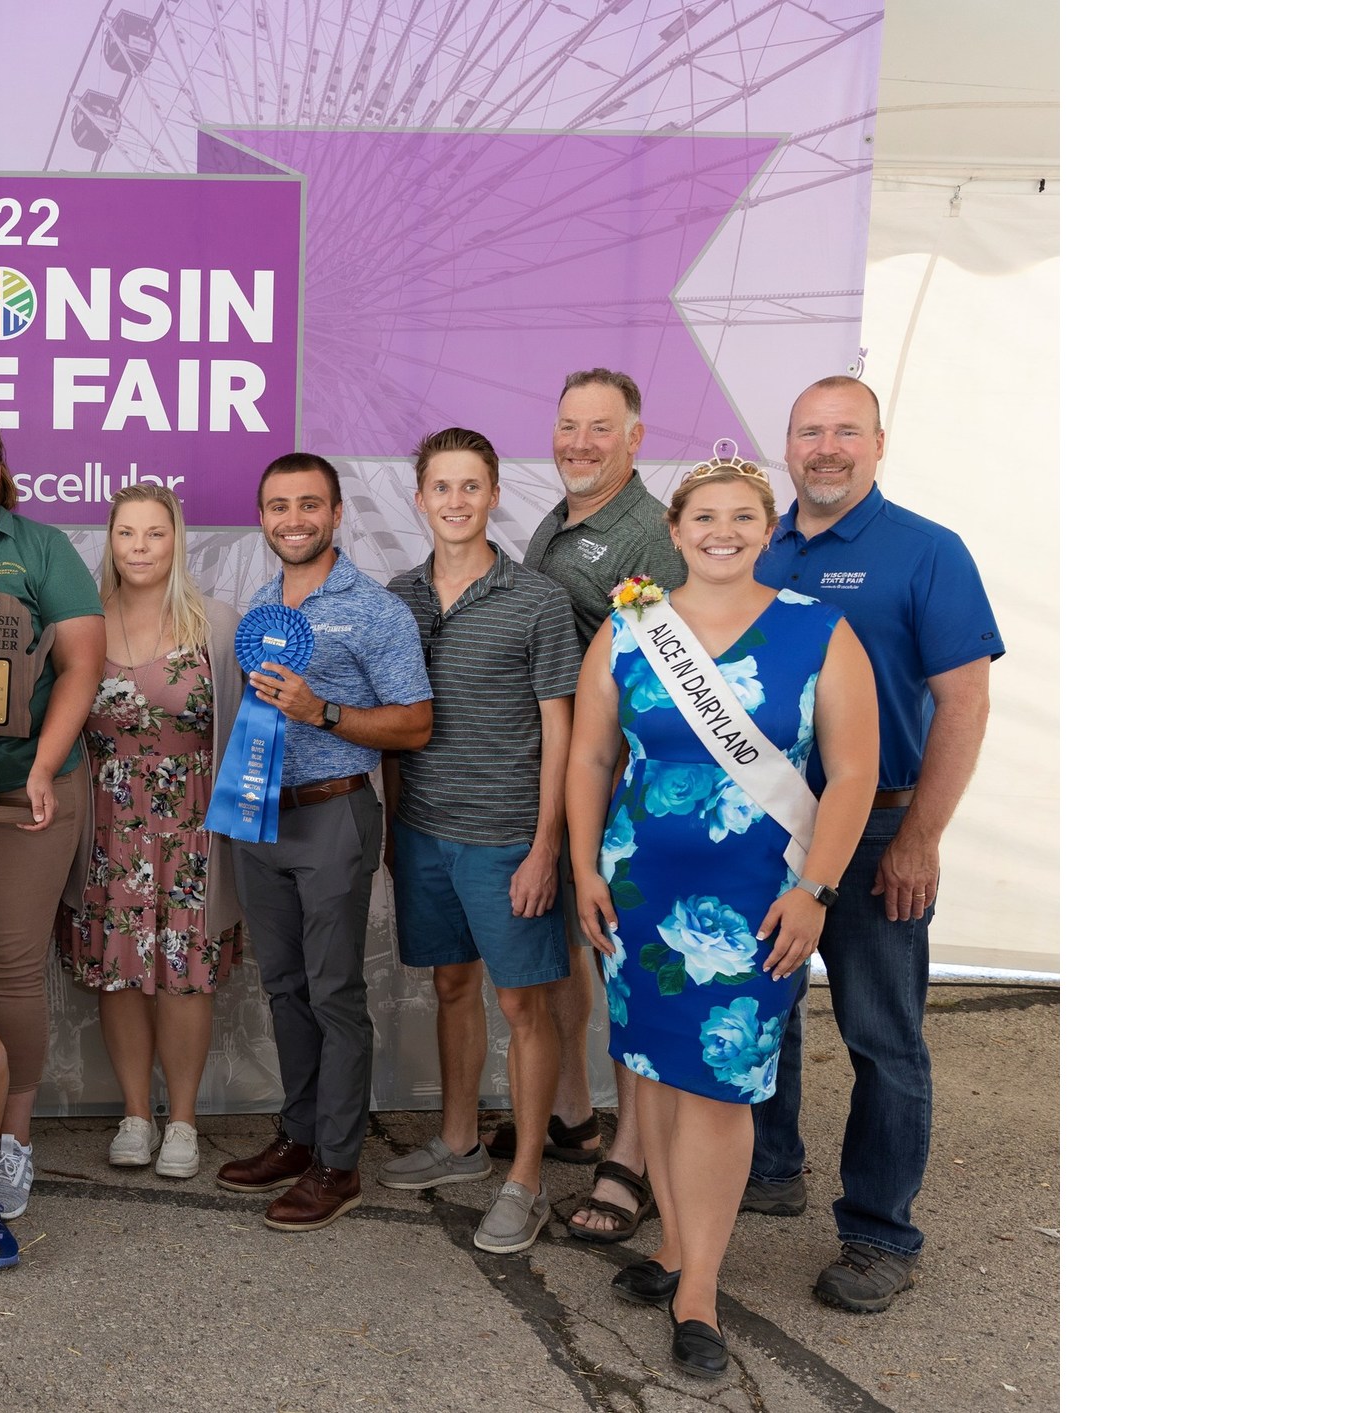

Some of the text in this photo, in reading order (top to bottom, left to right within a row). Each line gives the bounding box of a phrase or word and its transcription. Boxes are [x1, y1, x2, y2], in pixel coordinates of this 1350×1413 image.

[53, 357, 270, 433] FAIR
[647, 623, 760, 765] ALICE IN DAIRYLAND
